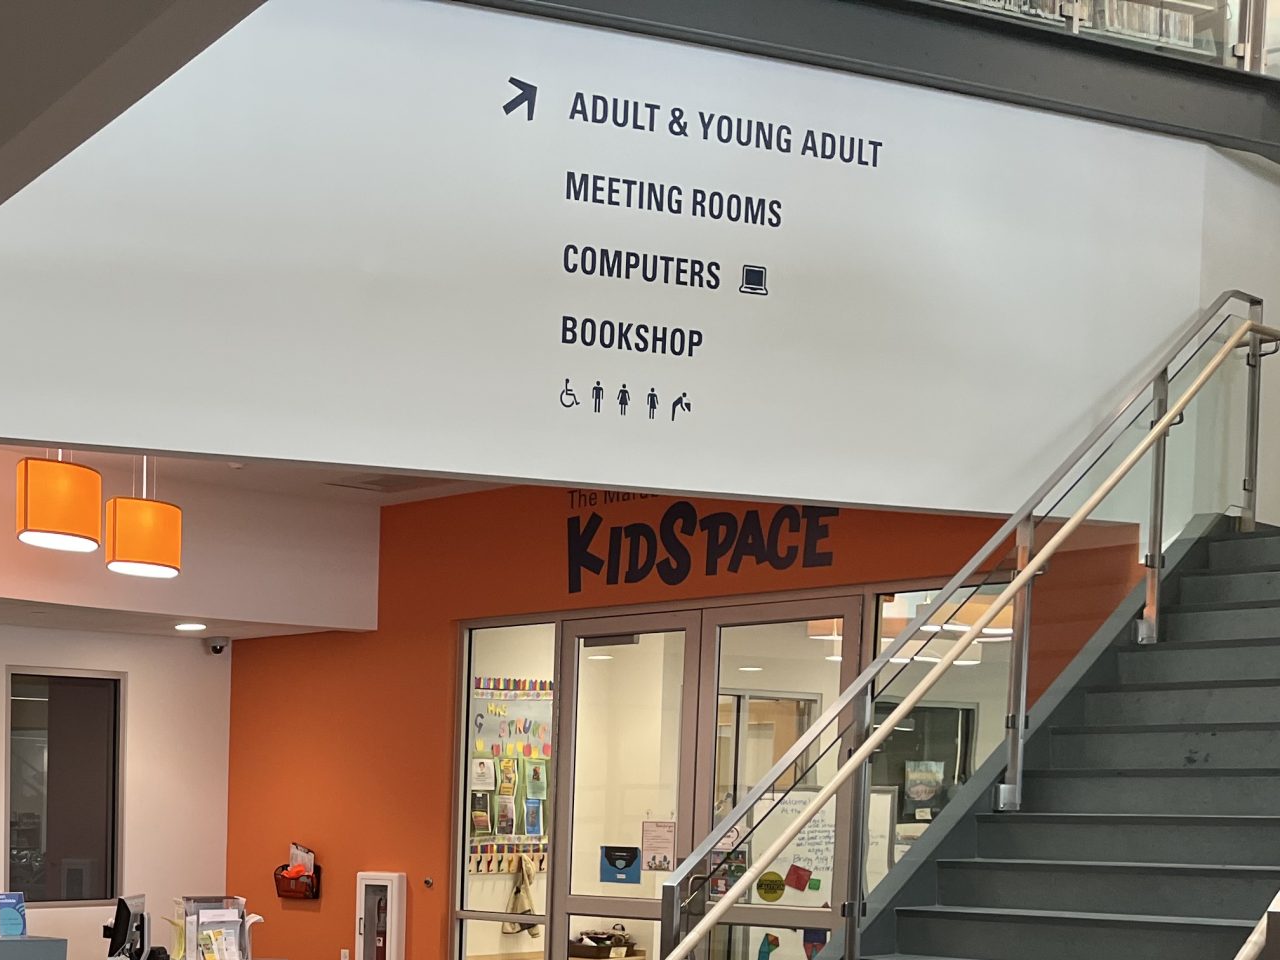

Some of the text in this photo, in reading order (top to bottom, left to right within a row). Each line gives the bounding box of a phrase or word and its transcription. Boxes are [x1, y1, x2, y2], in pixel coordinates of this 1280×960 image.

[569, 92, 883, 167] ADULT & YOUNG ADULT
[565, 171, 782, 227] MEETING ROOMS
[563, 244, 721, 290] COMPUTERS
[561, 315, 703, 357] BOOKSHOP
[567, 489, 598, 510] The
